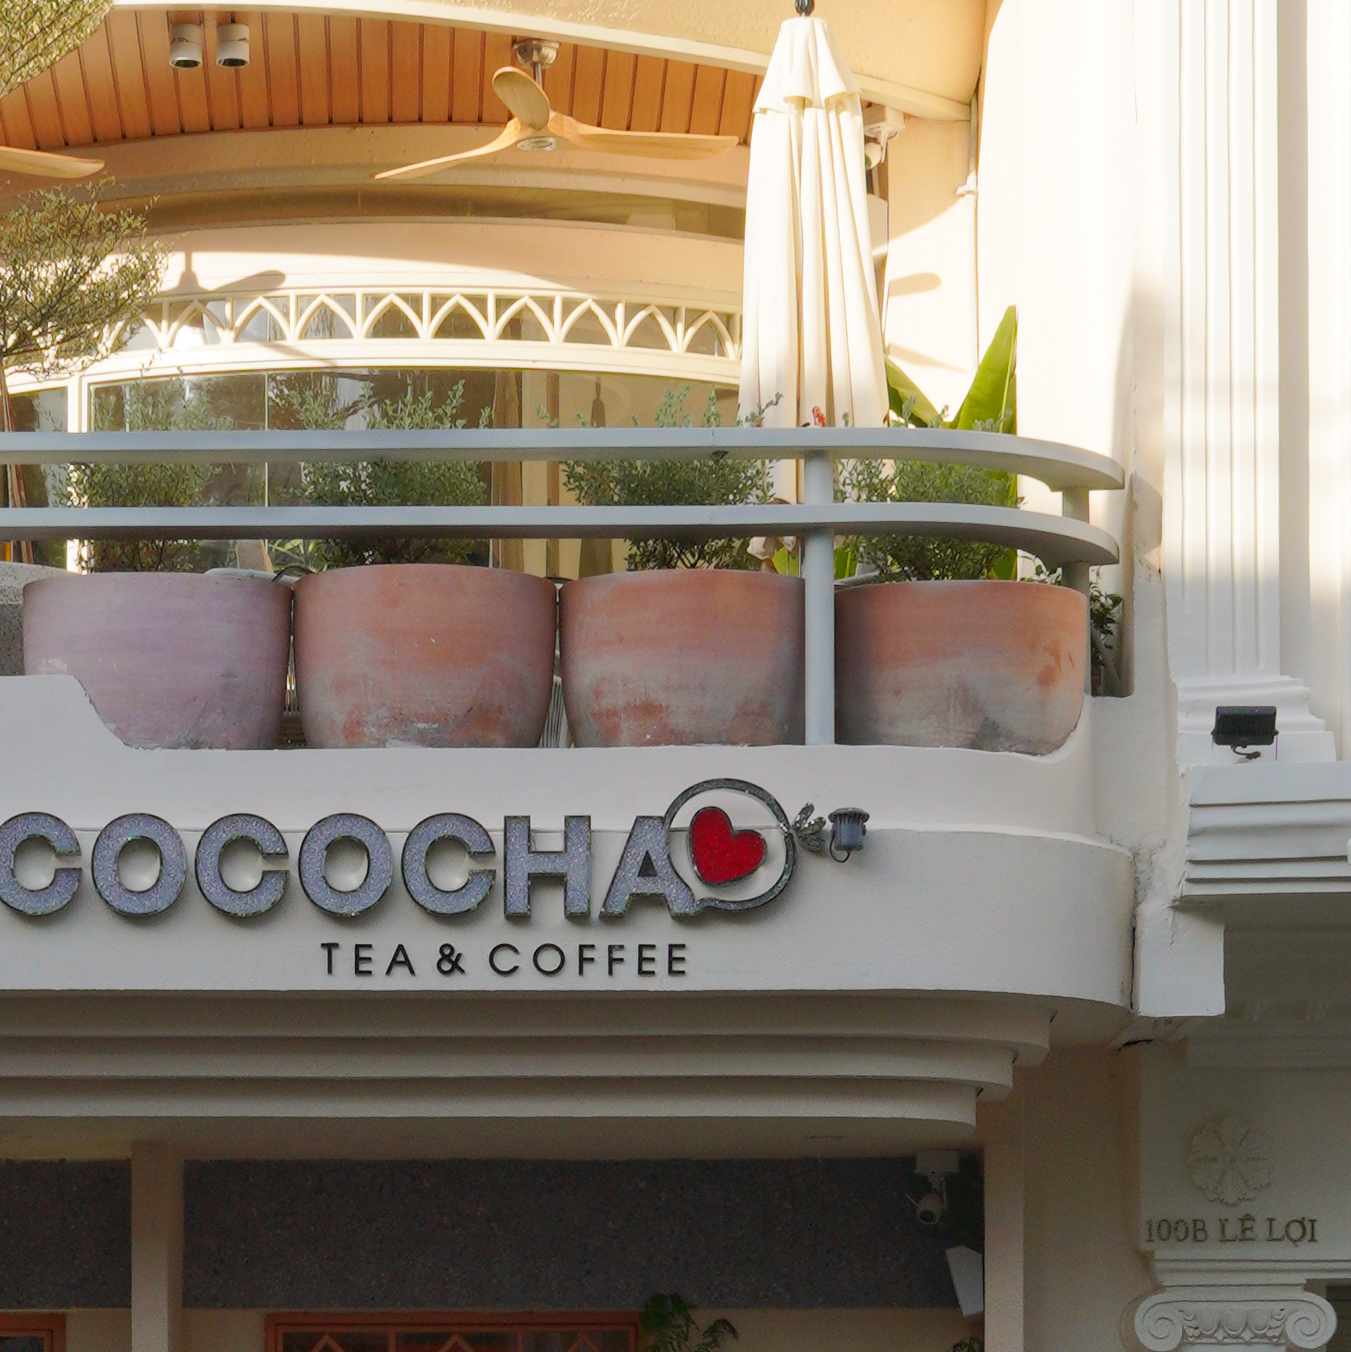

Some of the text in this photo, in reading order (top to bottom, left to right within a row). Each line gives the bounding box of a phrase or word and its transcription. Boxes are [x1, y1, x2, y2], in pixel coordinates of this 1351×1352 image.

[320, 942, 688, 977] TEA & COFFEE
[1145, 1213, 1318, 1247] 100B LÊ LỢI
